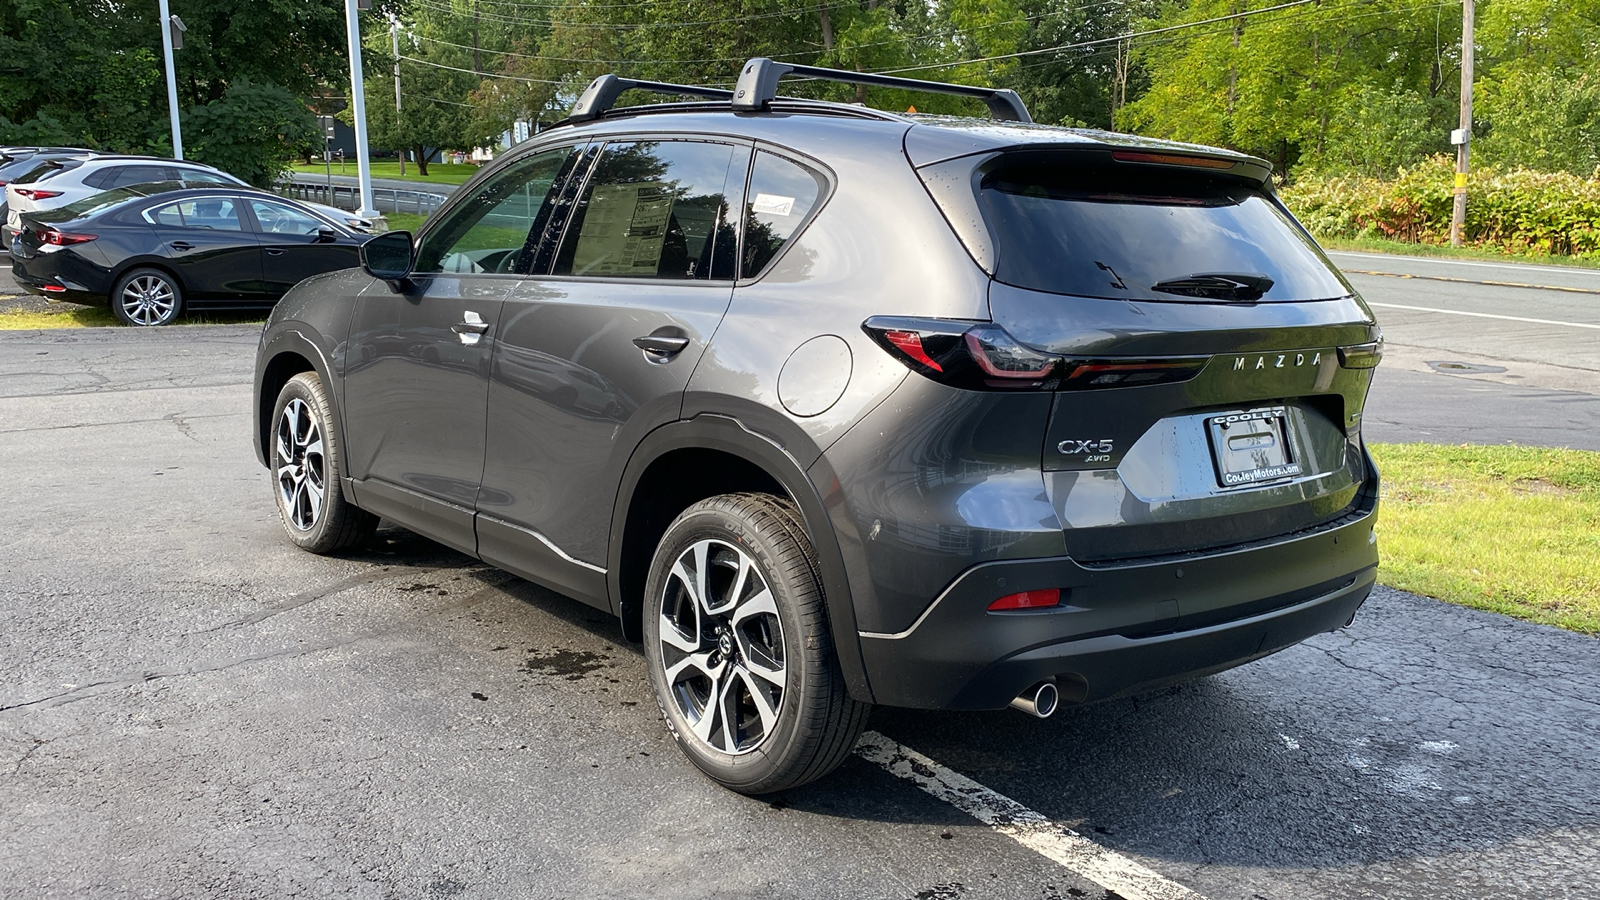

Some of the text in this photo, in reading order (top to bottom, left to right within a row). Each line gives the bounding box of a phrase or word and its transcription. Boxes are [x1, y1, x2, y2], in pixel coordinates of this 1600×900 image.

[1233, 352, 1321, 371] MAZDA
[1213, 410, 1283, 424] COOLEY
[1057, 438, 1114, 454] CX-5
[1084, 454, 1111, 463] AWD
[1225, 465, 1299, 484] CooleyMotors.com
